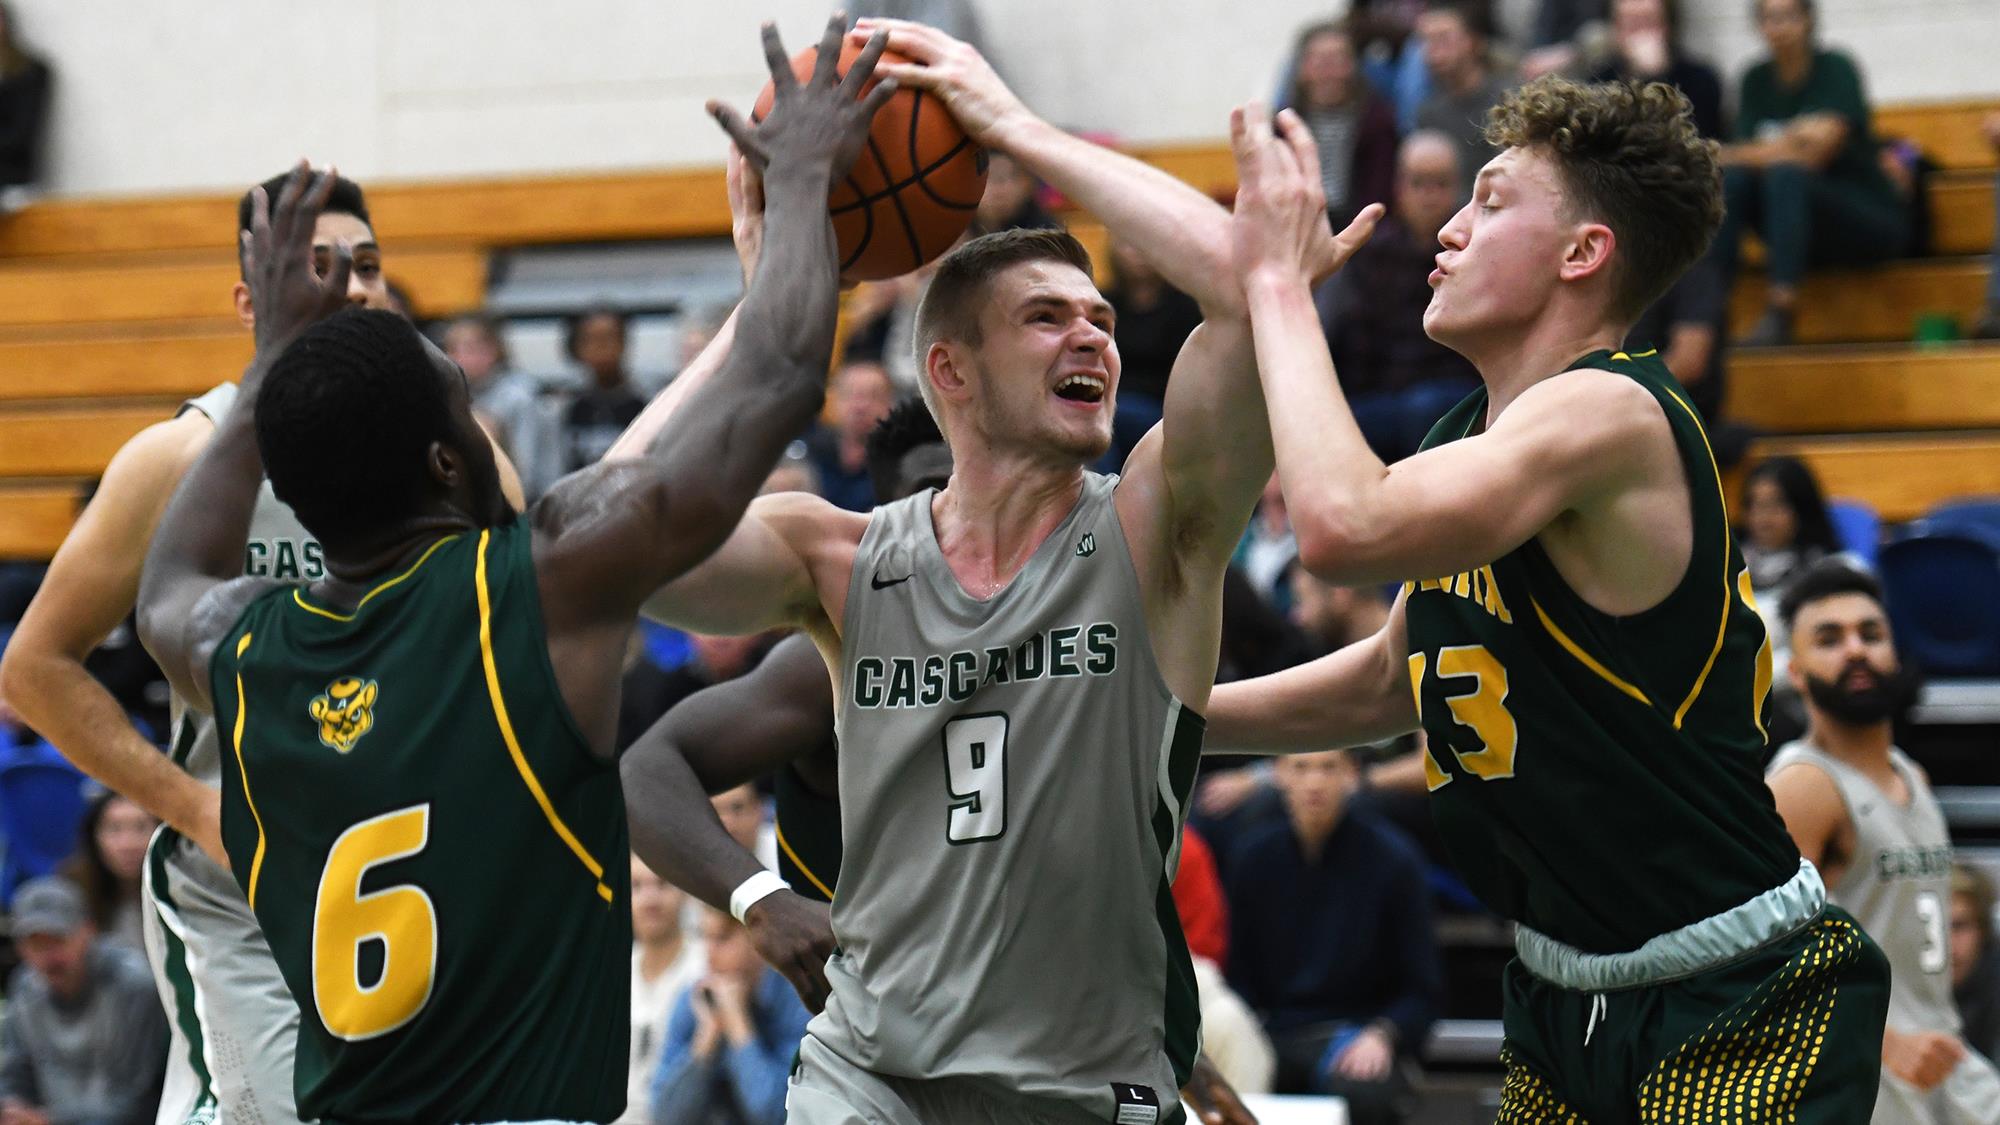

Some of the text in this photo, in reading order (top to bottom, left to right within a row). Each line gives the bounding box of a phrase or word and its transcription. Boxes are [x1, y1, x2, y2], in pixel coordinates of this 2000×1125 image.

[854, 622, 1118, 709] CASCADES
[942, 711, 1009, 846] 9
[312, 802, 438, 1042] 6
[1917, 890, 1945, 974] 3
[1129, 1087, 1144, 1100] L
